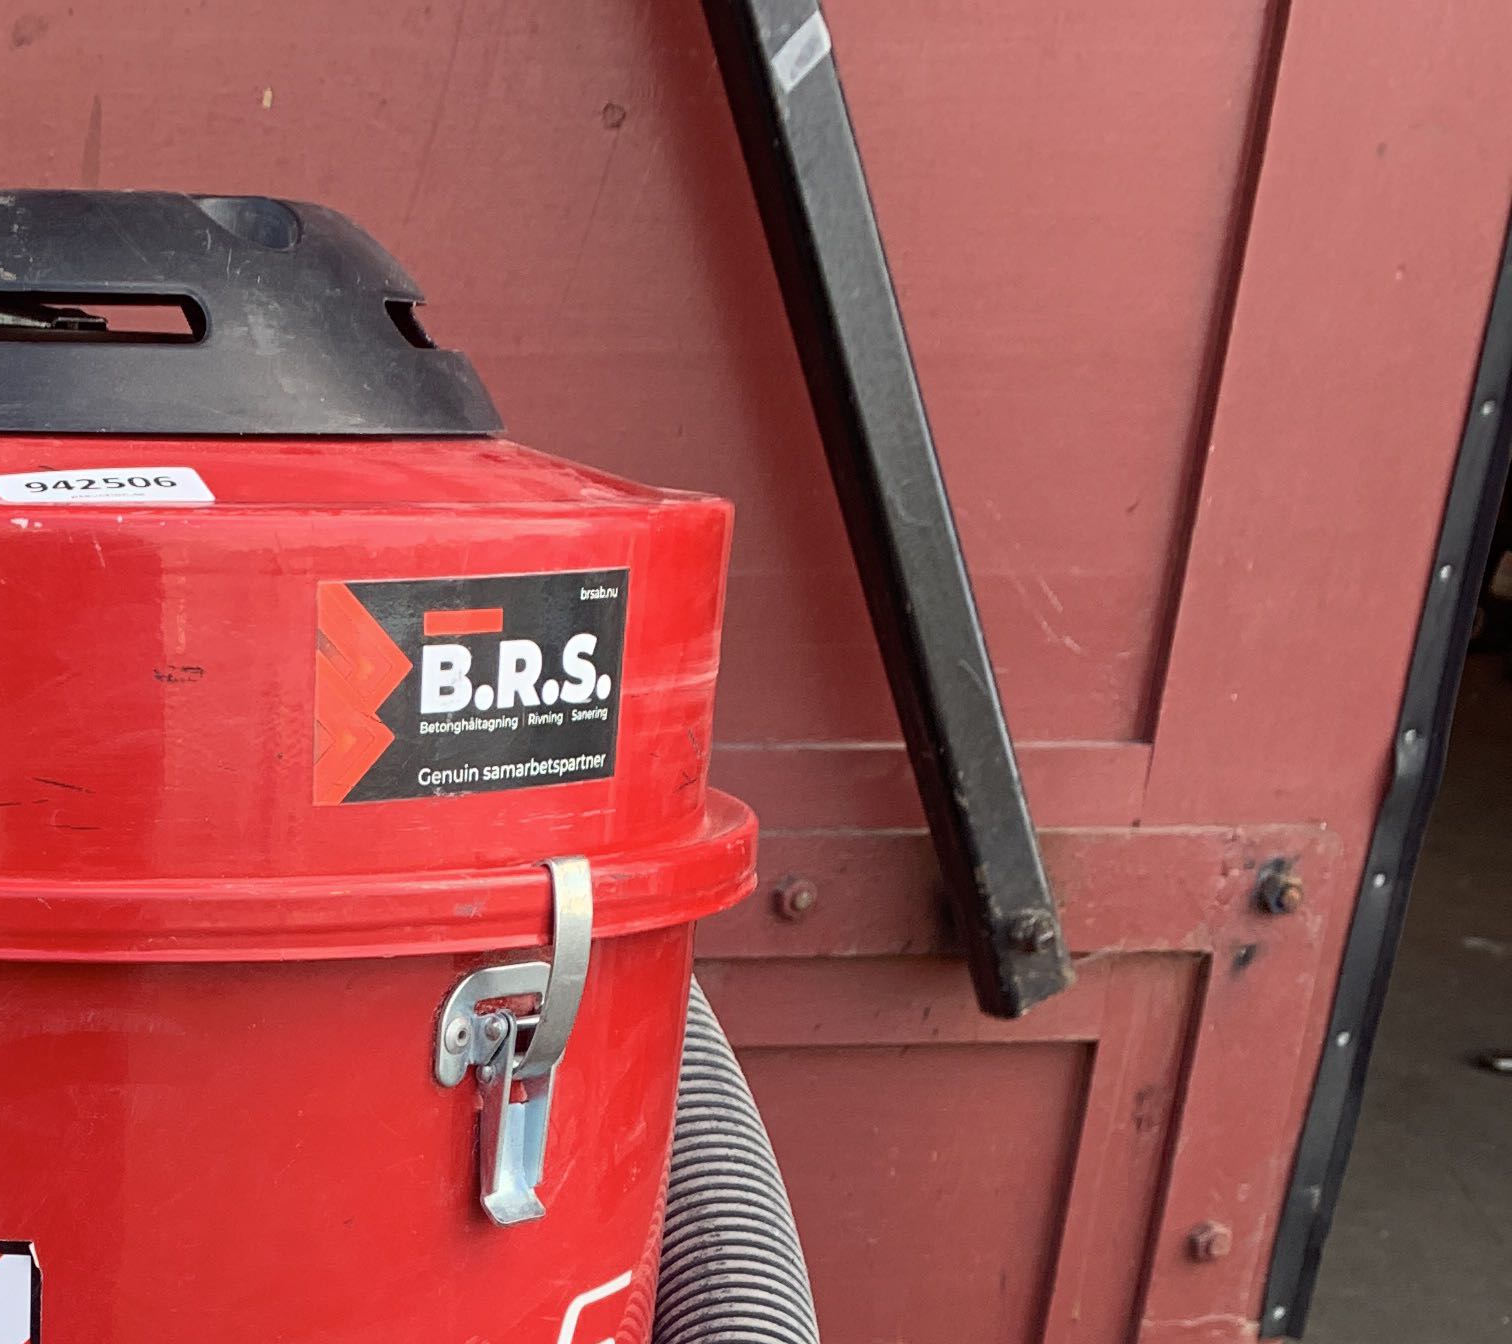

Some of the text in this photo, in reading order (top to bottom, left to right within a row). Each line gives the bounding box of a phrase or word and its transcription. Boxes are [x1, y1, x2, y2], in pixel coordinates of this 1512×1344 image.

[24, 475, 177, 493] 942506
[580, 586, 618, 600] brsab.nu
[420, 633, 611, 714] B.R.S.
[420, 706, 608, 734] Betonghåltagning Rivning Sanering
[418, 753, 606, 785] Genuin samarbetspartner
